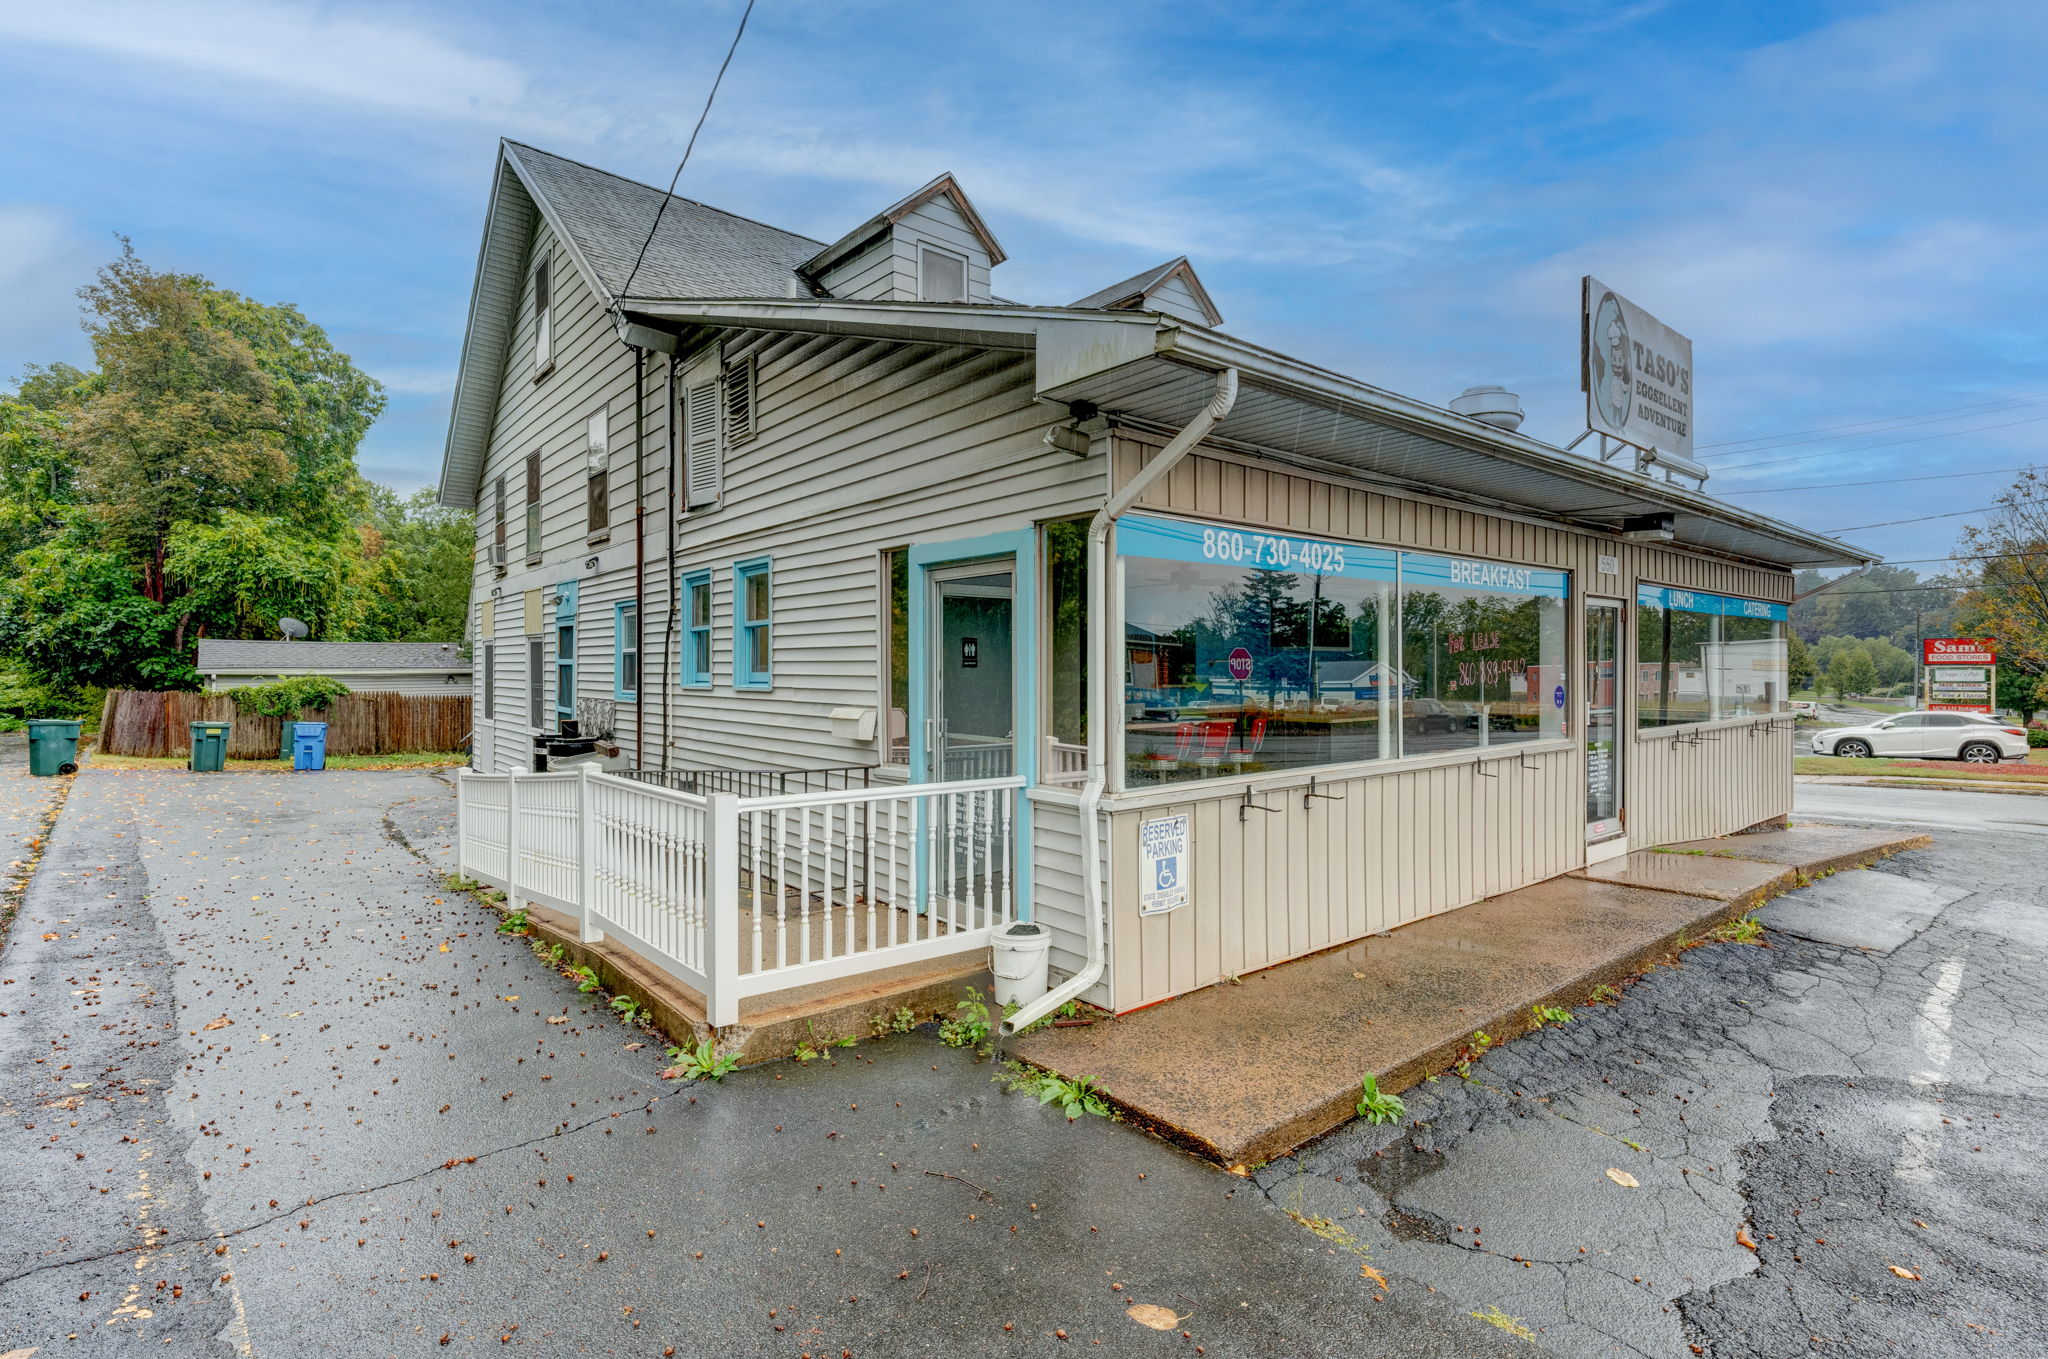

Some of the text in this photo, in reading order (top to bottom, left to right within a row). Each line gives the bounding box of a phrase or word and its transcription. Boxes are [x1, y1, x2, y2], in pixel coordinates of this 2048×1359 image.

[1633, 340, 1689, 395] TASO'S
[1636, 379, 1688, 417] EGGSELLENT
[1637, 403, 1687, 438] ADVENTURE
[1203, 528, 1345, 572] 860-730-4025
[1450, 560, 1532, 590] BREAKFAST
[1668, 589, 1694, 609] LUNCH
[1743, 600, 1771, 618] CATERING
[1933, 640, 1985, 653] Sam's
[1142, 818, 1186, 842] RESERVED
[1146, 838, 1183, 859] PARKING
